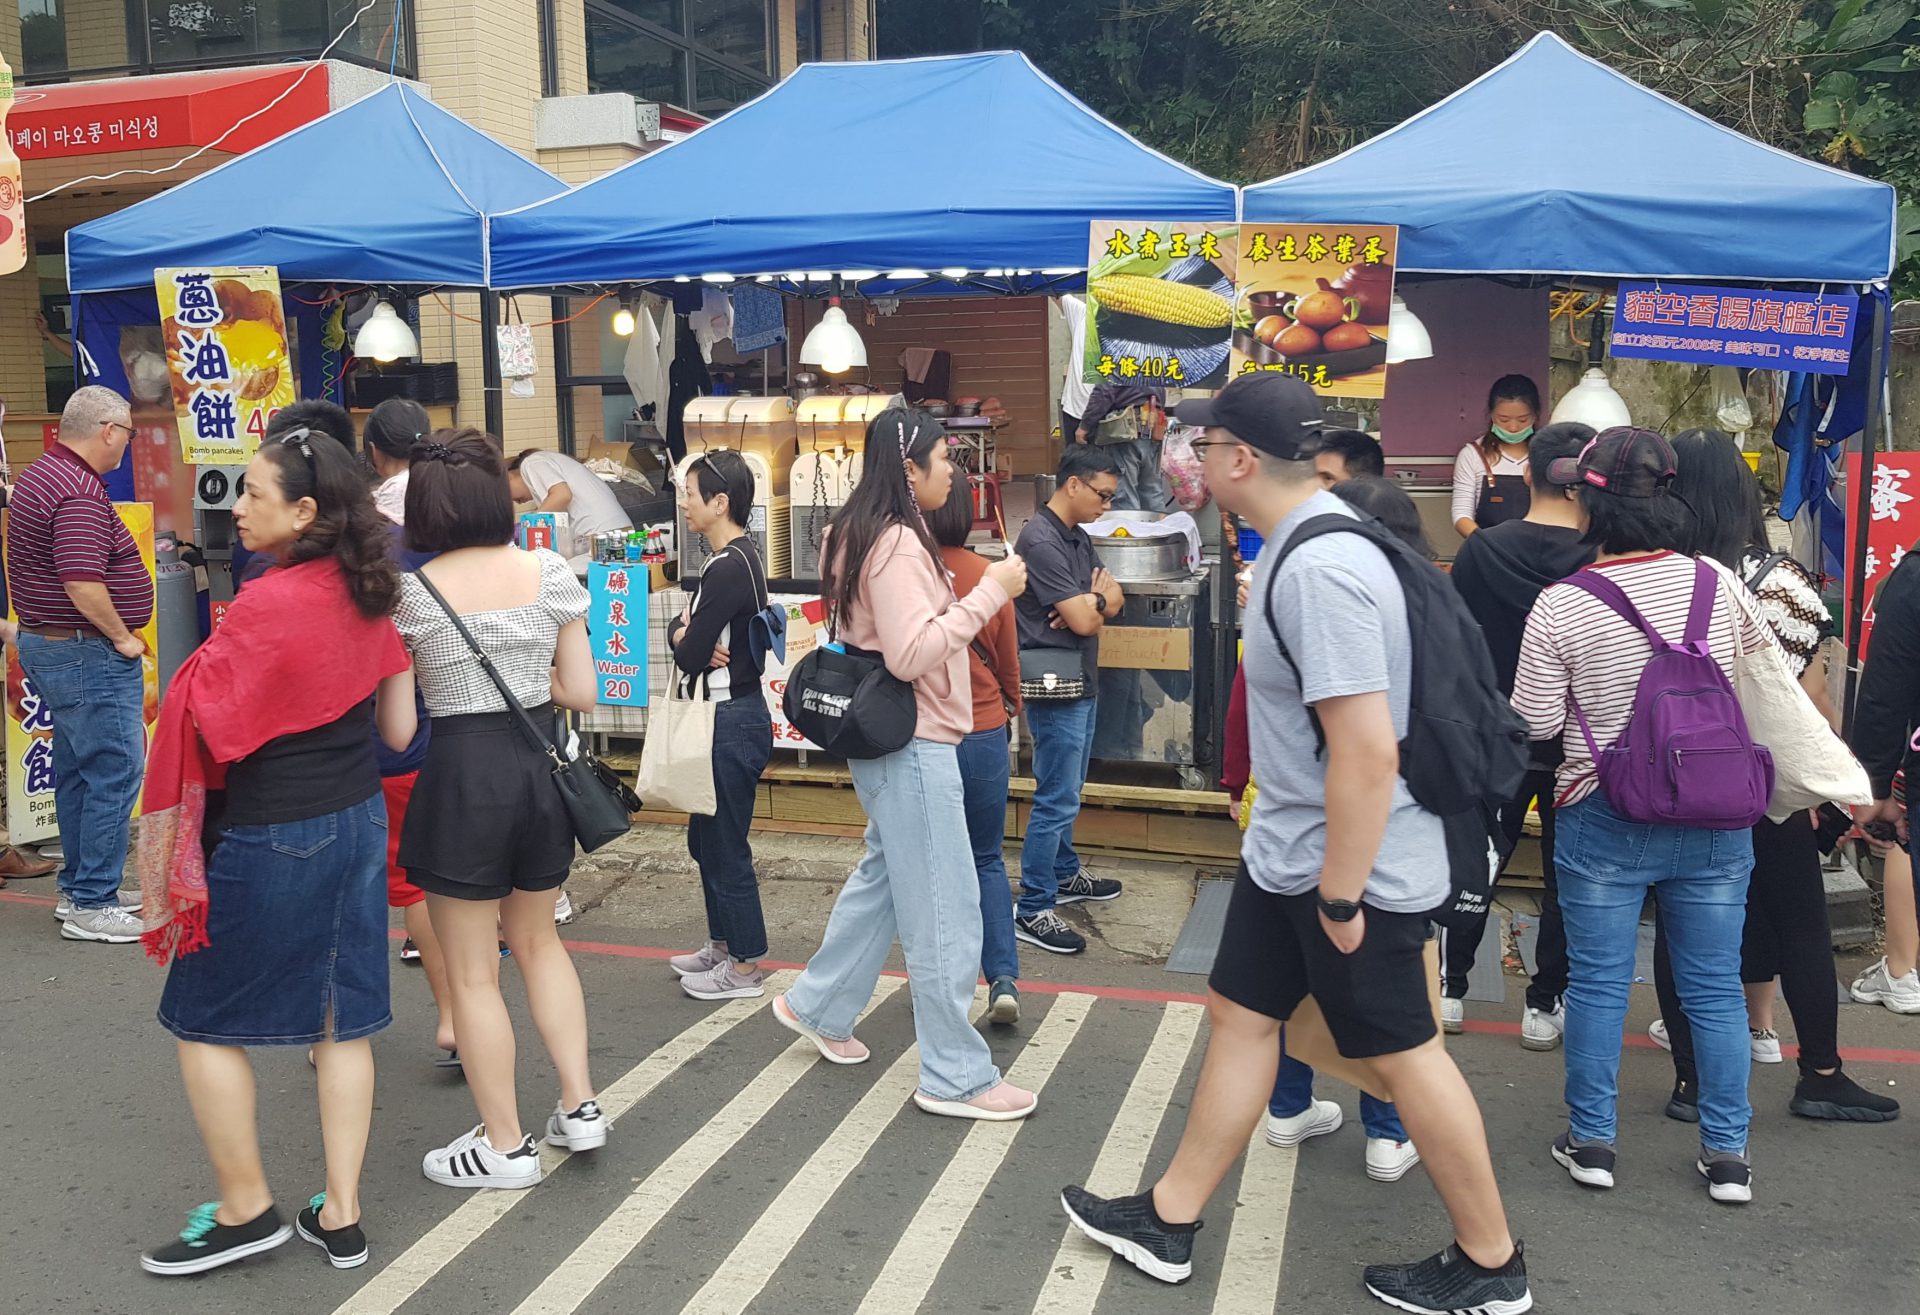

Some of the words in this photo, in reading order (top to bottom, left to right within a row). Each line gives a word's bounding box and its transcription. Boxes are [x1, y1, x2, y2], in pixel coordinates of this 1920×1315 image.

[53, 122, 104, 148] 마오콩
[109, 115, 159, 142] 미식성
[1107, 228, 1222, 260] 水煮玉米
[1243, 231, 1388, 265] 養生茶葉蛋
[1623, 290, 1850, 338] 貓空香腸旗艦店
[1095, 355, 1185, 381] 每條40元
[189, 446, 210, 454] Bomb
[211, 447, 244, 456] pancakes
[604, 569, 629, 657] 礦泉水
[597, 660, 639, 676] Water
[605, 680, 631, 698] 20
[803, 699, 817, 712] ALL
[817, 703, 843, 718] STAR
[30, 800, 55, 812] Bom
